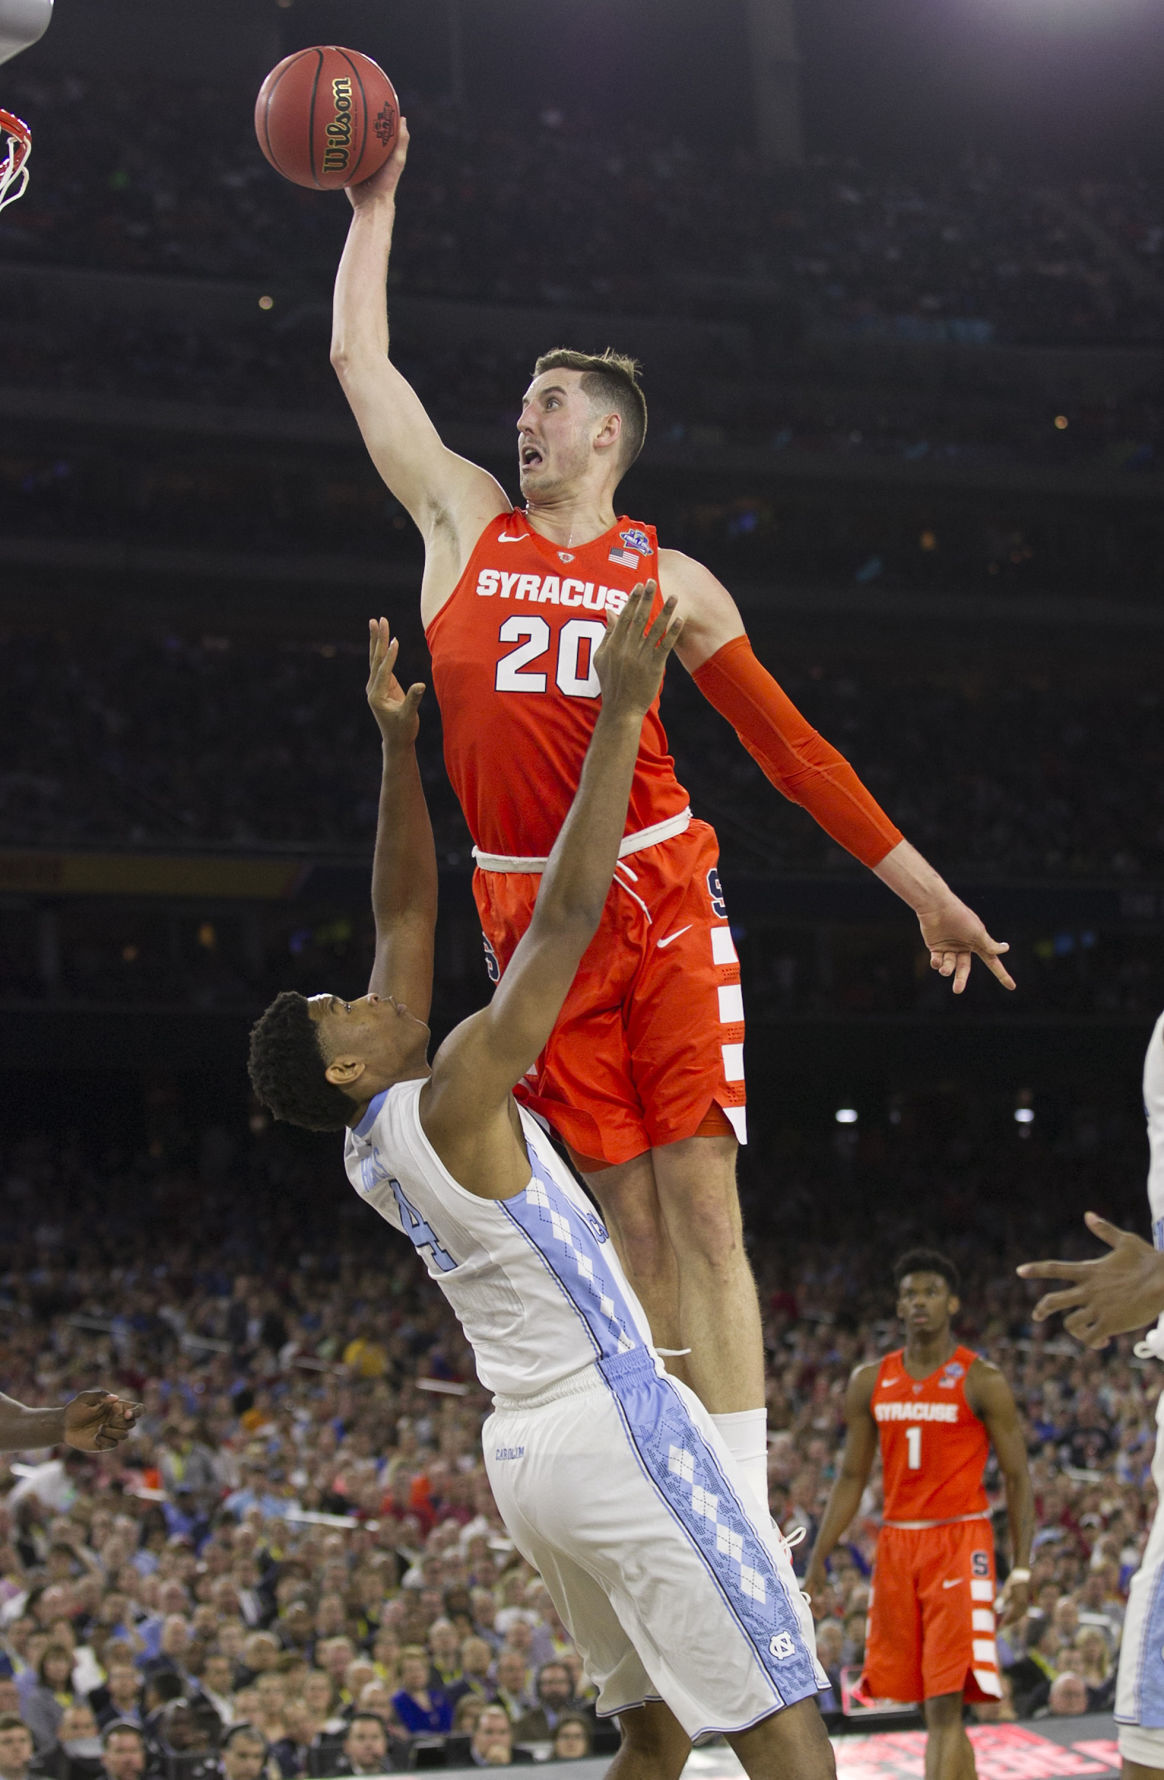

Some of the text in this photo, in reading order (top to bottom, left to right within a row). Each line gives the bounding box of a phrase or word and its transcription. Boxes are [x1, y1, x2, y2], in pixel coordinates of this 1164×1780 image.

[323, 78, 351, 172] Wilson
[476, 568, 629, 615] SYRACUS
[495, 615, 607, 698] 20
[874, 1401, 958, 1423] SYRACUSE
[905, 1426, 921, 1470] 1
[971, 1550, 989, 1577] S
